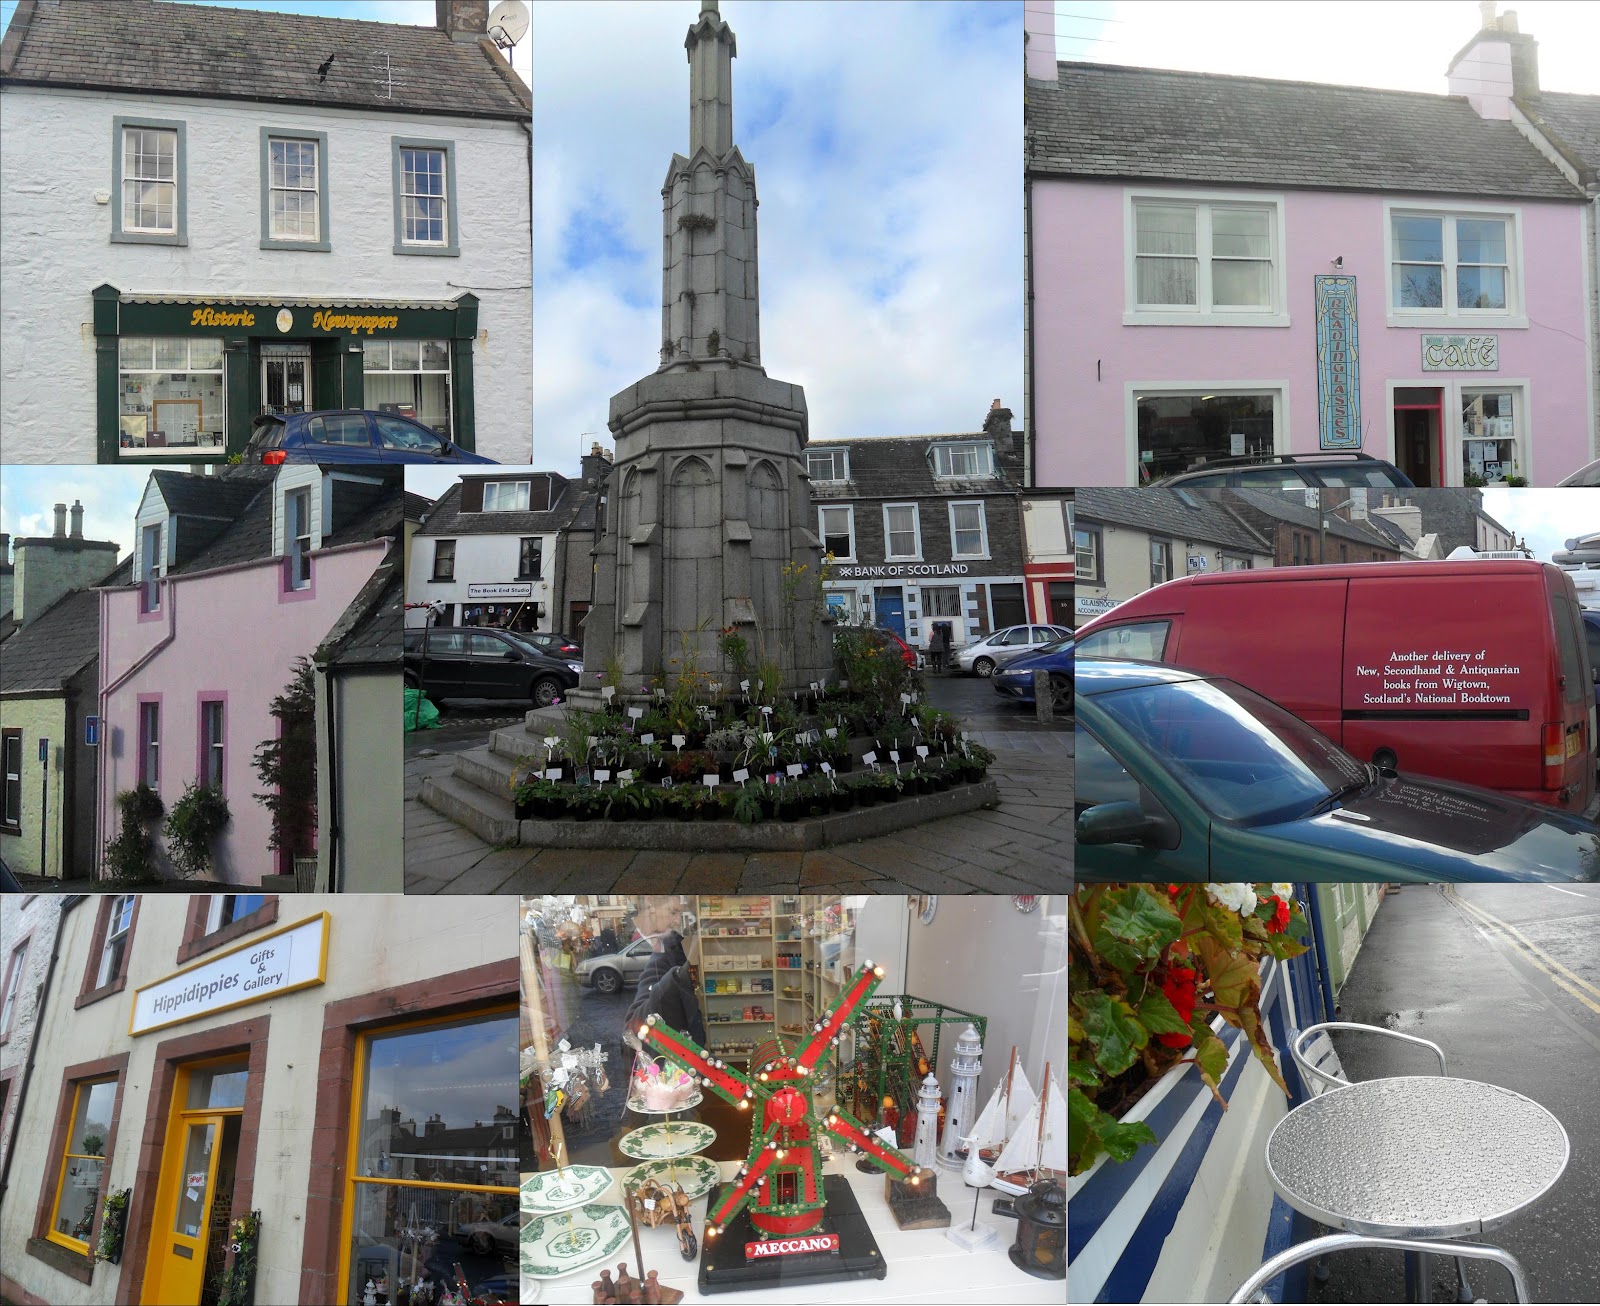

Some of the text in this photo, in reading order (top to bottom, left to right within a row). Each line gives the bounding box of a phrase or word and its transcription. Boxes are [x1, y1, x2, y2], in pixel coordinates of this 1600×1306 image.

[191, 307, 399, 335] Historic Newspapers
[854, 564, 969, 576] BANK OF SCOTLAND
[488, 605, 495, 614] a
[1390, 650, 1486, 662] Another delivery of
[1356, 664, 1520, 677] New, Secondhand & Antiquarian
[1384, 678, 1490, 691] books from Wigtown,
[1364, 693, 1511, 704] Scotland's National Booktown
[250, 949, 275, 965] Gifts
[257, 962, 266, 974] &
[153, 972, 283, 1014] Hippidippies Gallery
[753, 1237, 832, 1256] MECCANO
